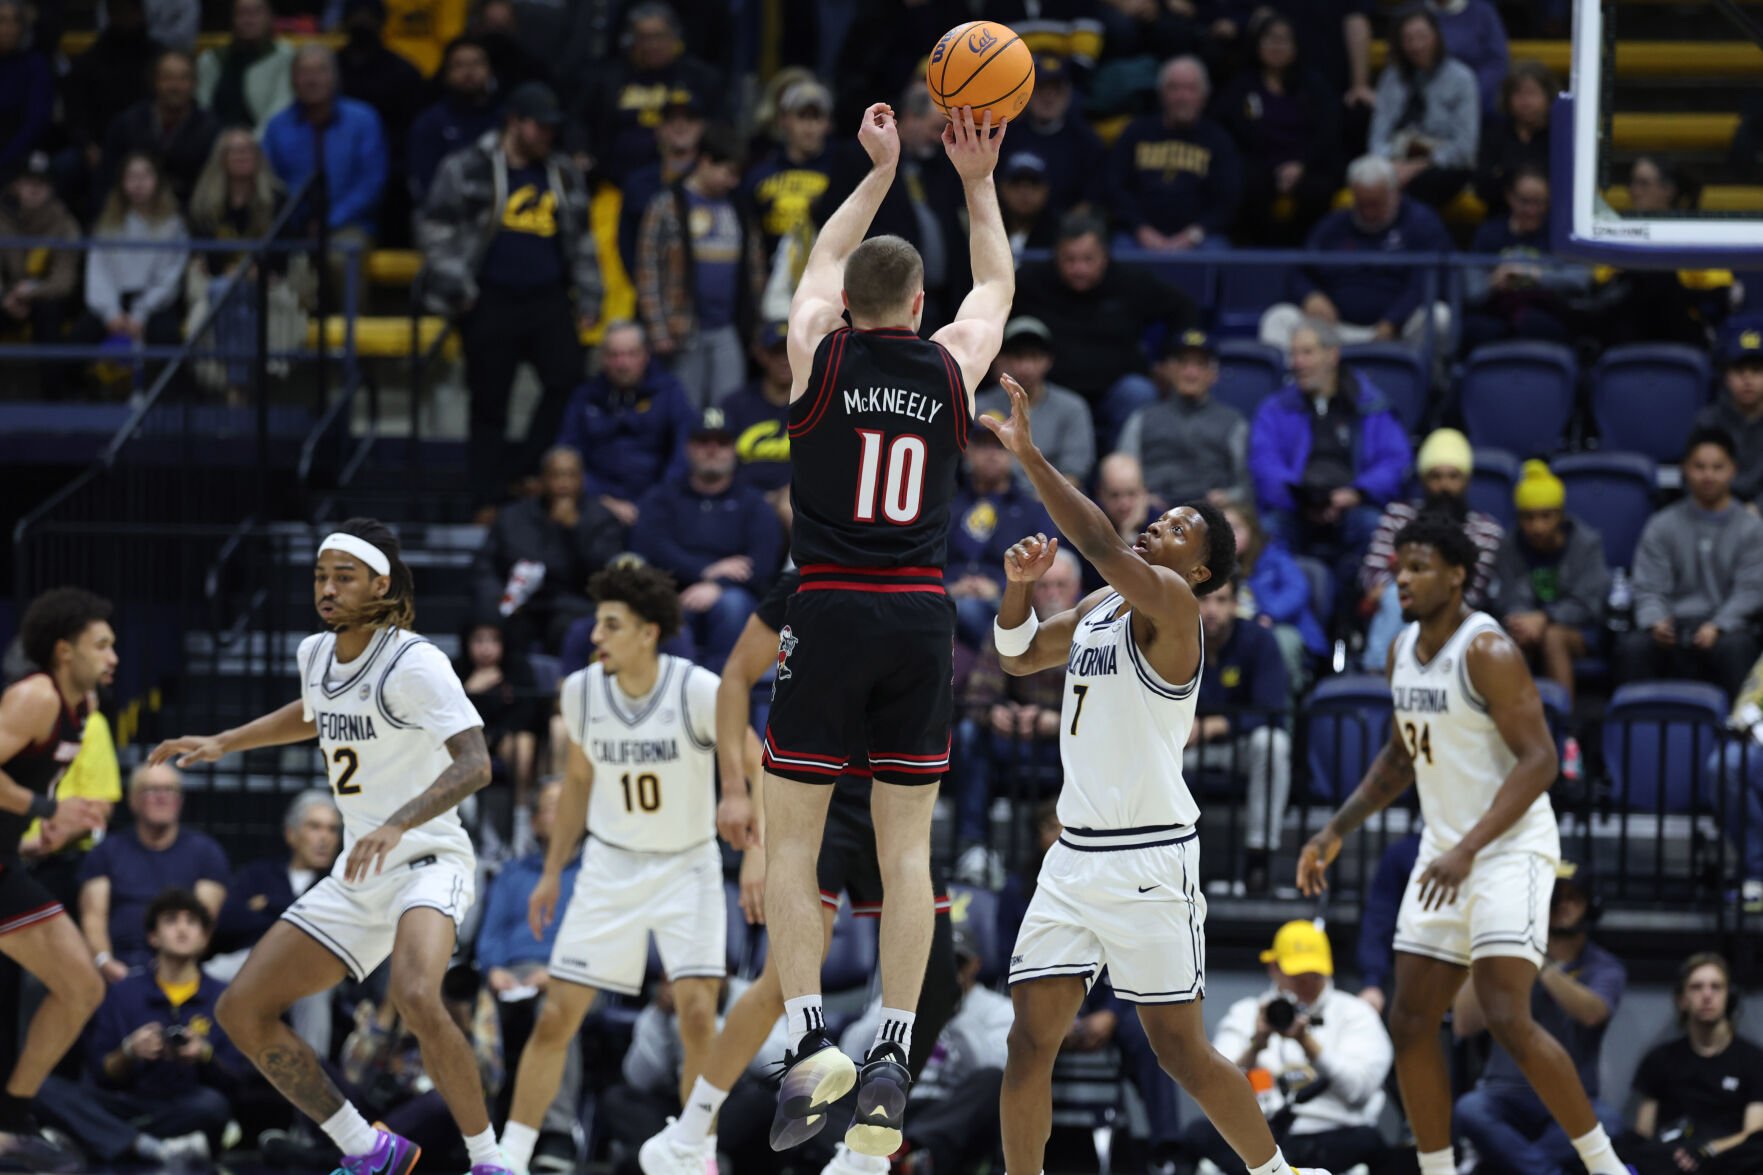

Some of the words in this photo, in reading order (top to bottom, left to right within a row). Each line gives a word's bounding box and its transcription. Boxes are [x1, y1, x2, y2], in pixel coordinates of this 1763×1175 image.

[968, 28, 998, 57] Cal
[843, 387, 943, 424] McKNEELY
[853, 427, 928, 526] 10
[1070, 684, 1089, 736] 7
[1404, 720, 1434, 767] 34
[320, 745, 362, 796] 2
[620, 771, 662, 814] 10
